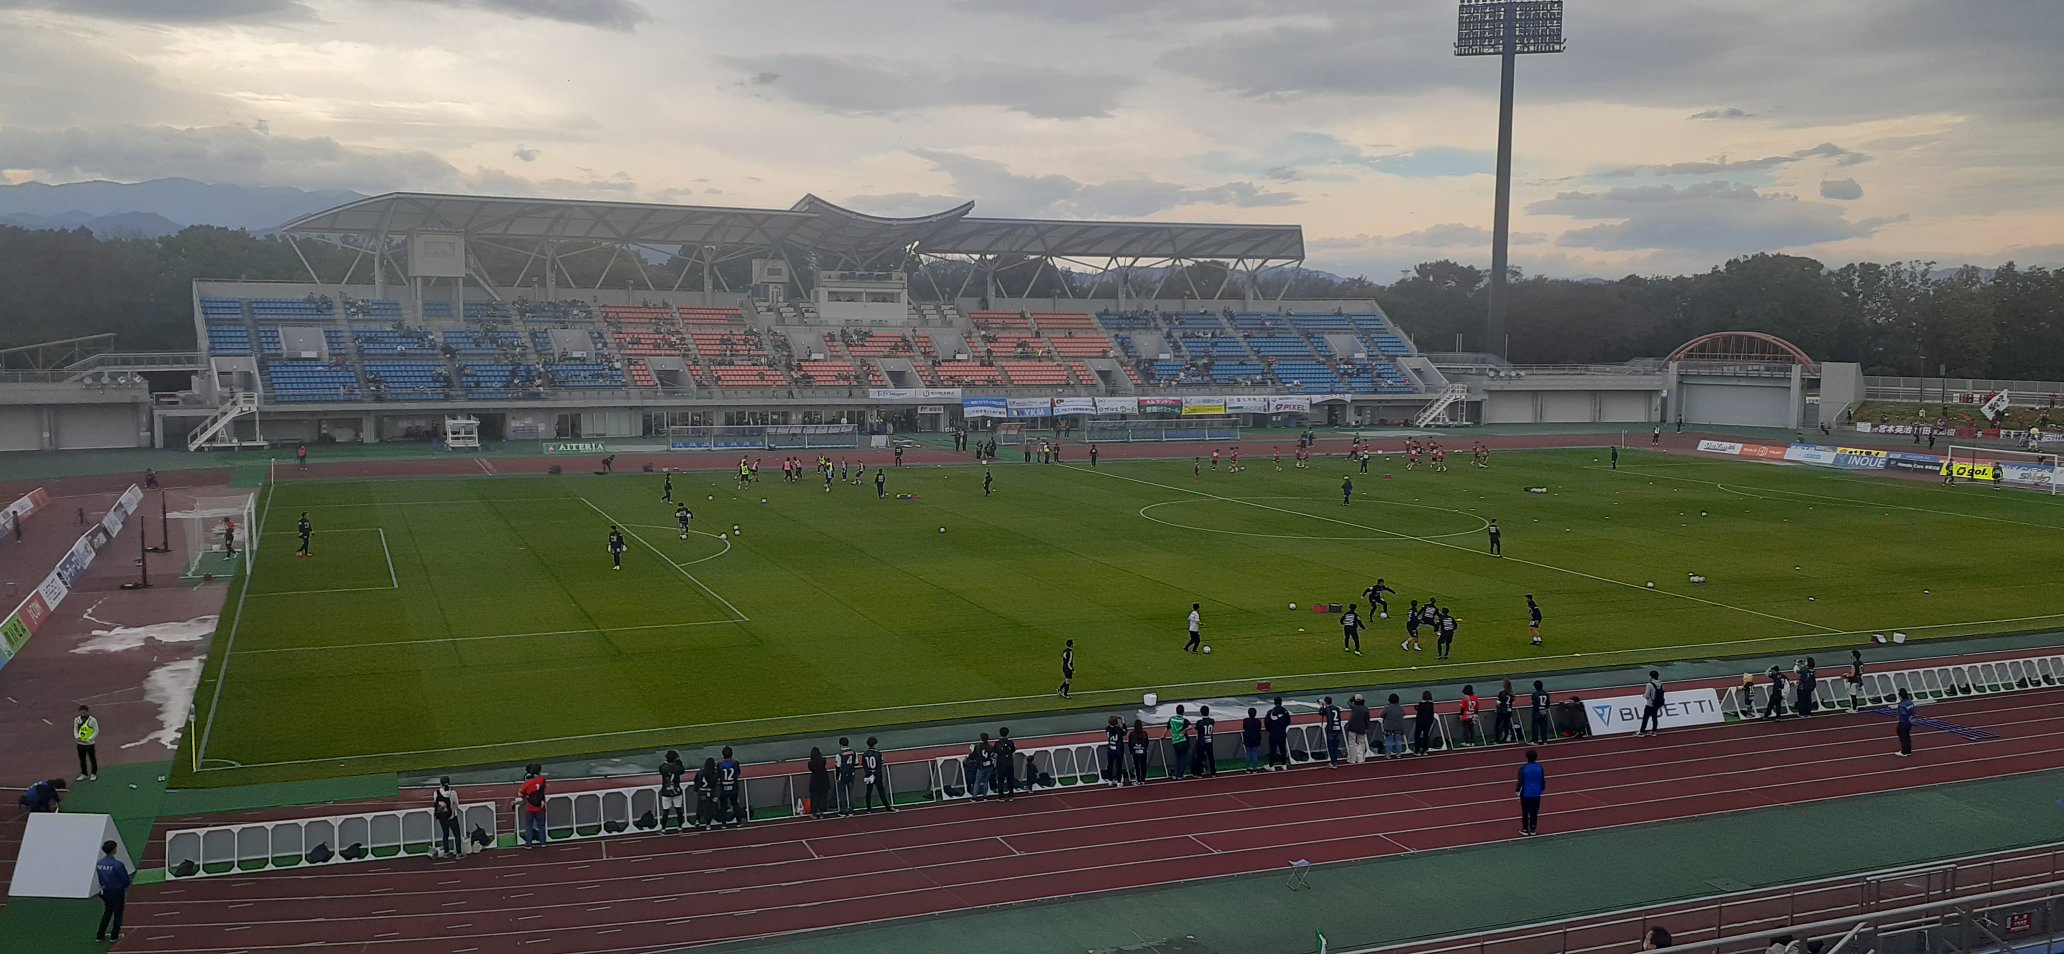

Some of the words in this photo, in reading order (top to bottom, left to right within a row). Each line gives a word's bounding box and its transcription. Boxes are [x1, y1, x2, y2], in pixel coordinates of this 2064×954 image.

[1024, 408, 1045, 416] YKM
[1878, 424, 1913, 434] 宮本英治
[558, 443, 604, 451] AITERIA
[1847, 455, 1887, 468] INOUE
[1332, 709, 1339, 721] 2
[1619, 699, 1714, 721] BLETTI
[1203, 725, 1213, 735] 10
[846, 755, 853, 765] 4
[864, 756, 877, 769] 10
[722, 768, 734, 781] 12
